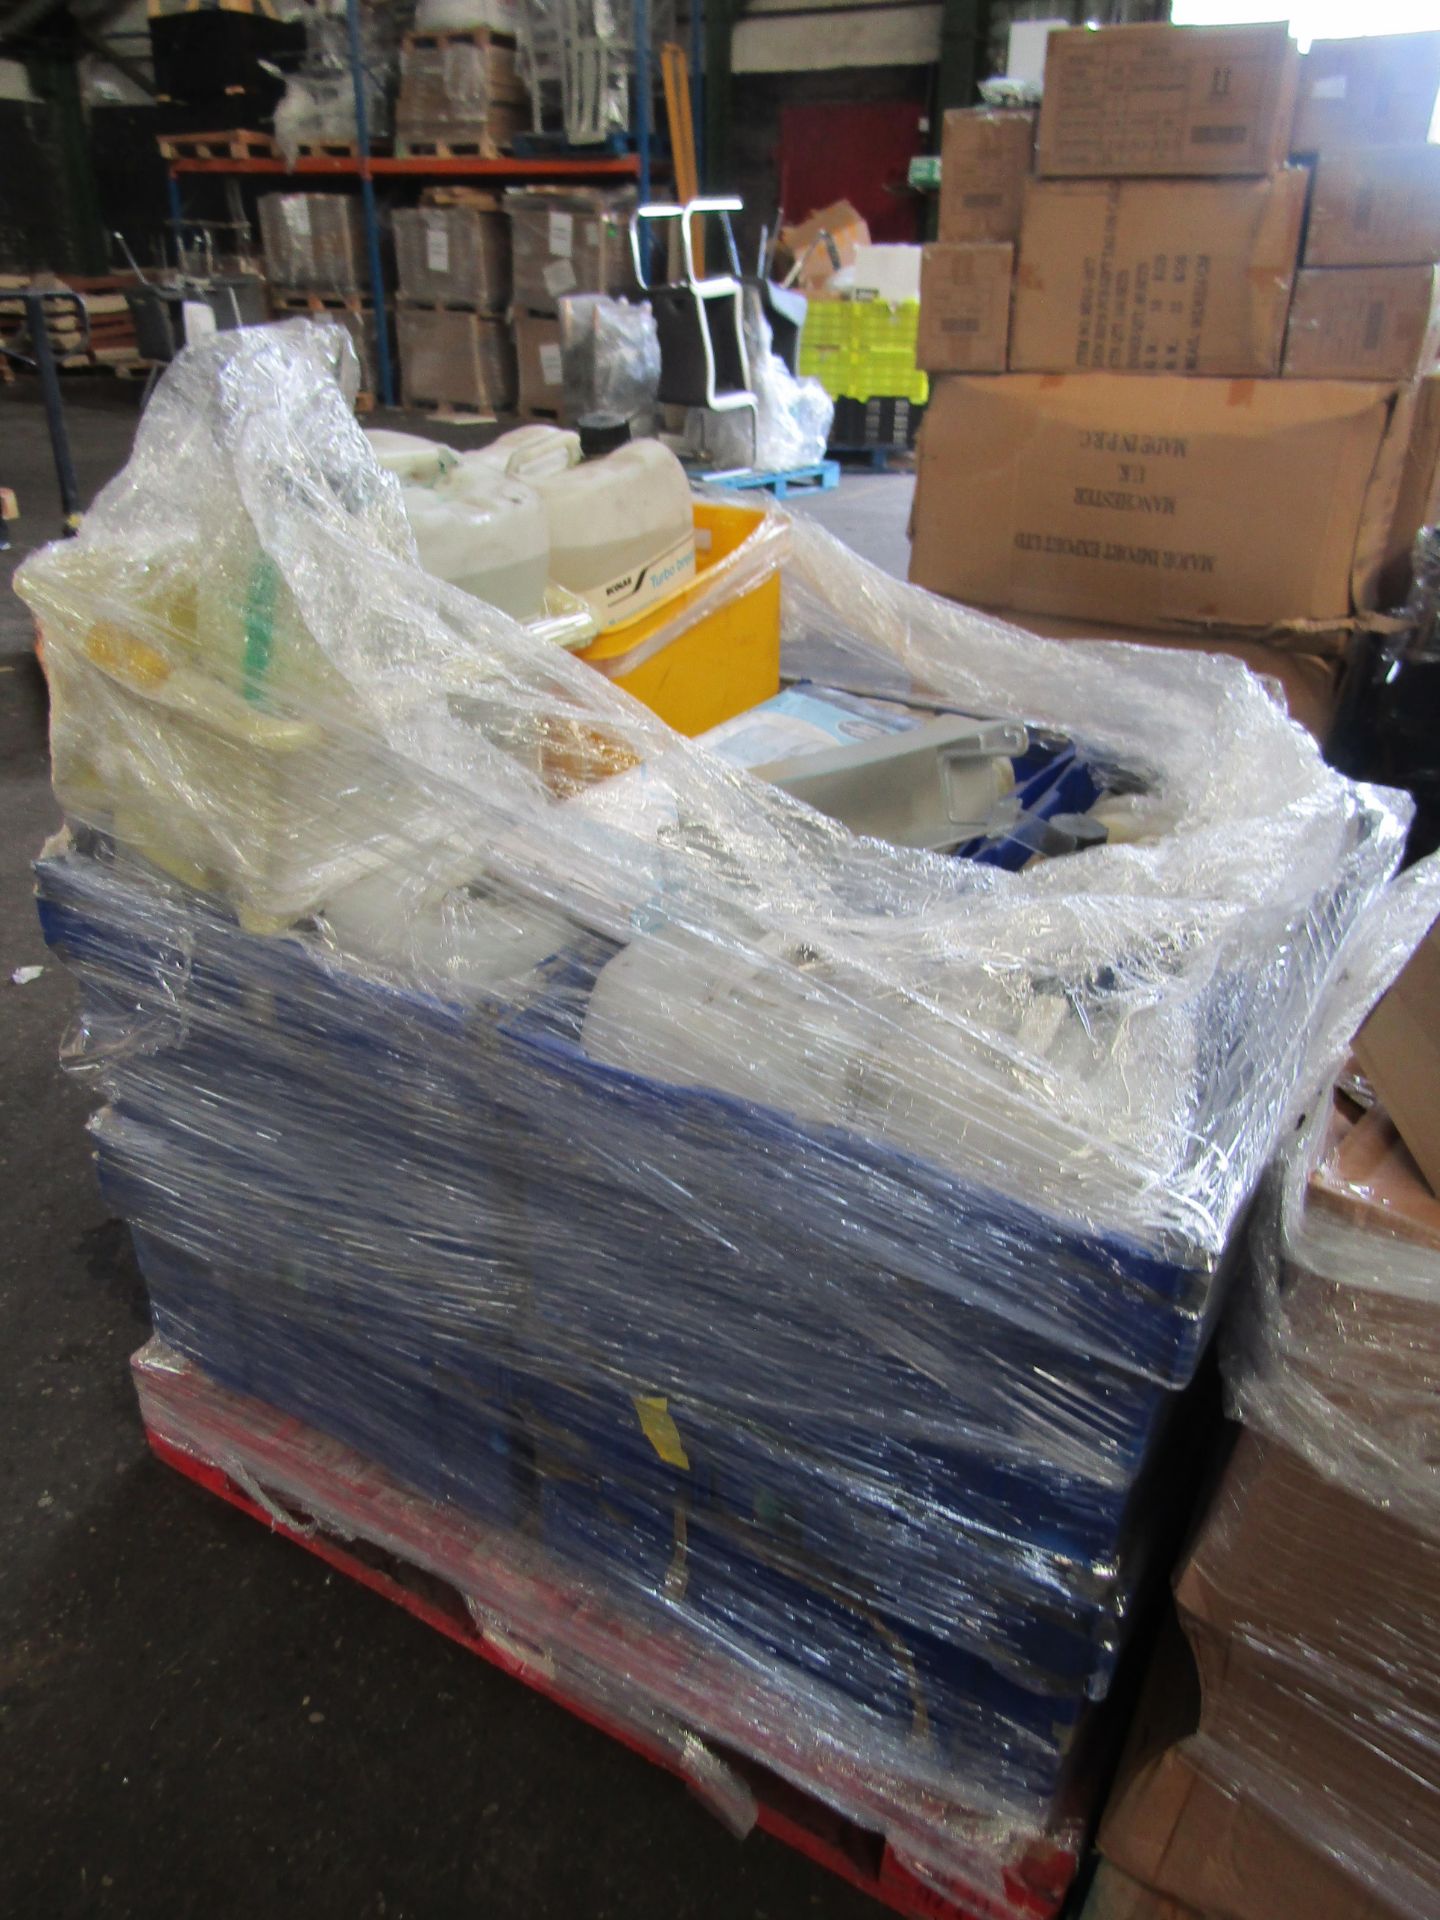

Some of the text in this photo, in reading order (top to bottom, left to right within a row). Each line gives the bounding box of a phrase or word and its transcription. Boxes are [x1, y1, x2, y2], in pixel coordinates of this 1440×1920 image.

[1074, 488, 1175, 516] MANCHESTER
[1015, 533, 1213, 573] MAJOR IMPORT EXPORT LTD
